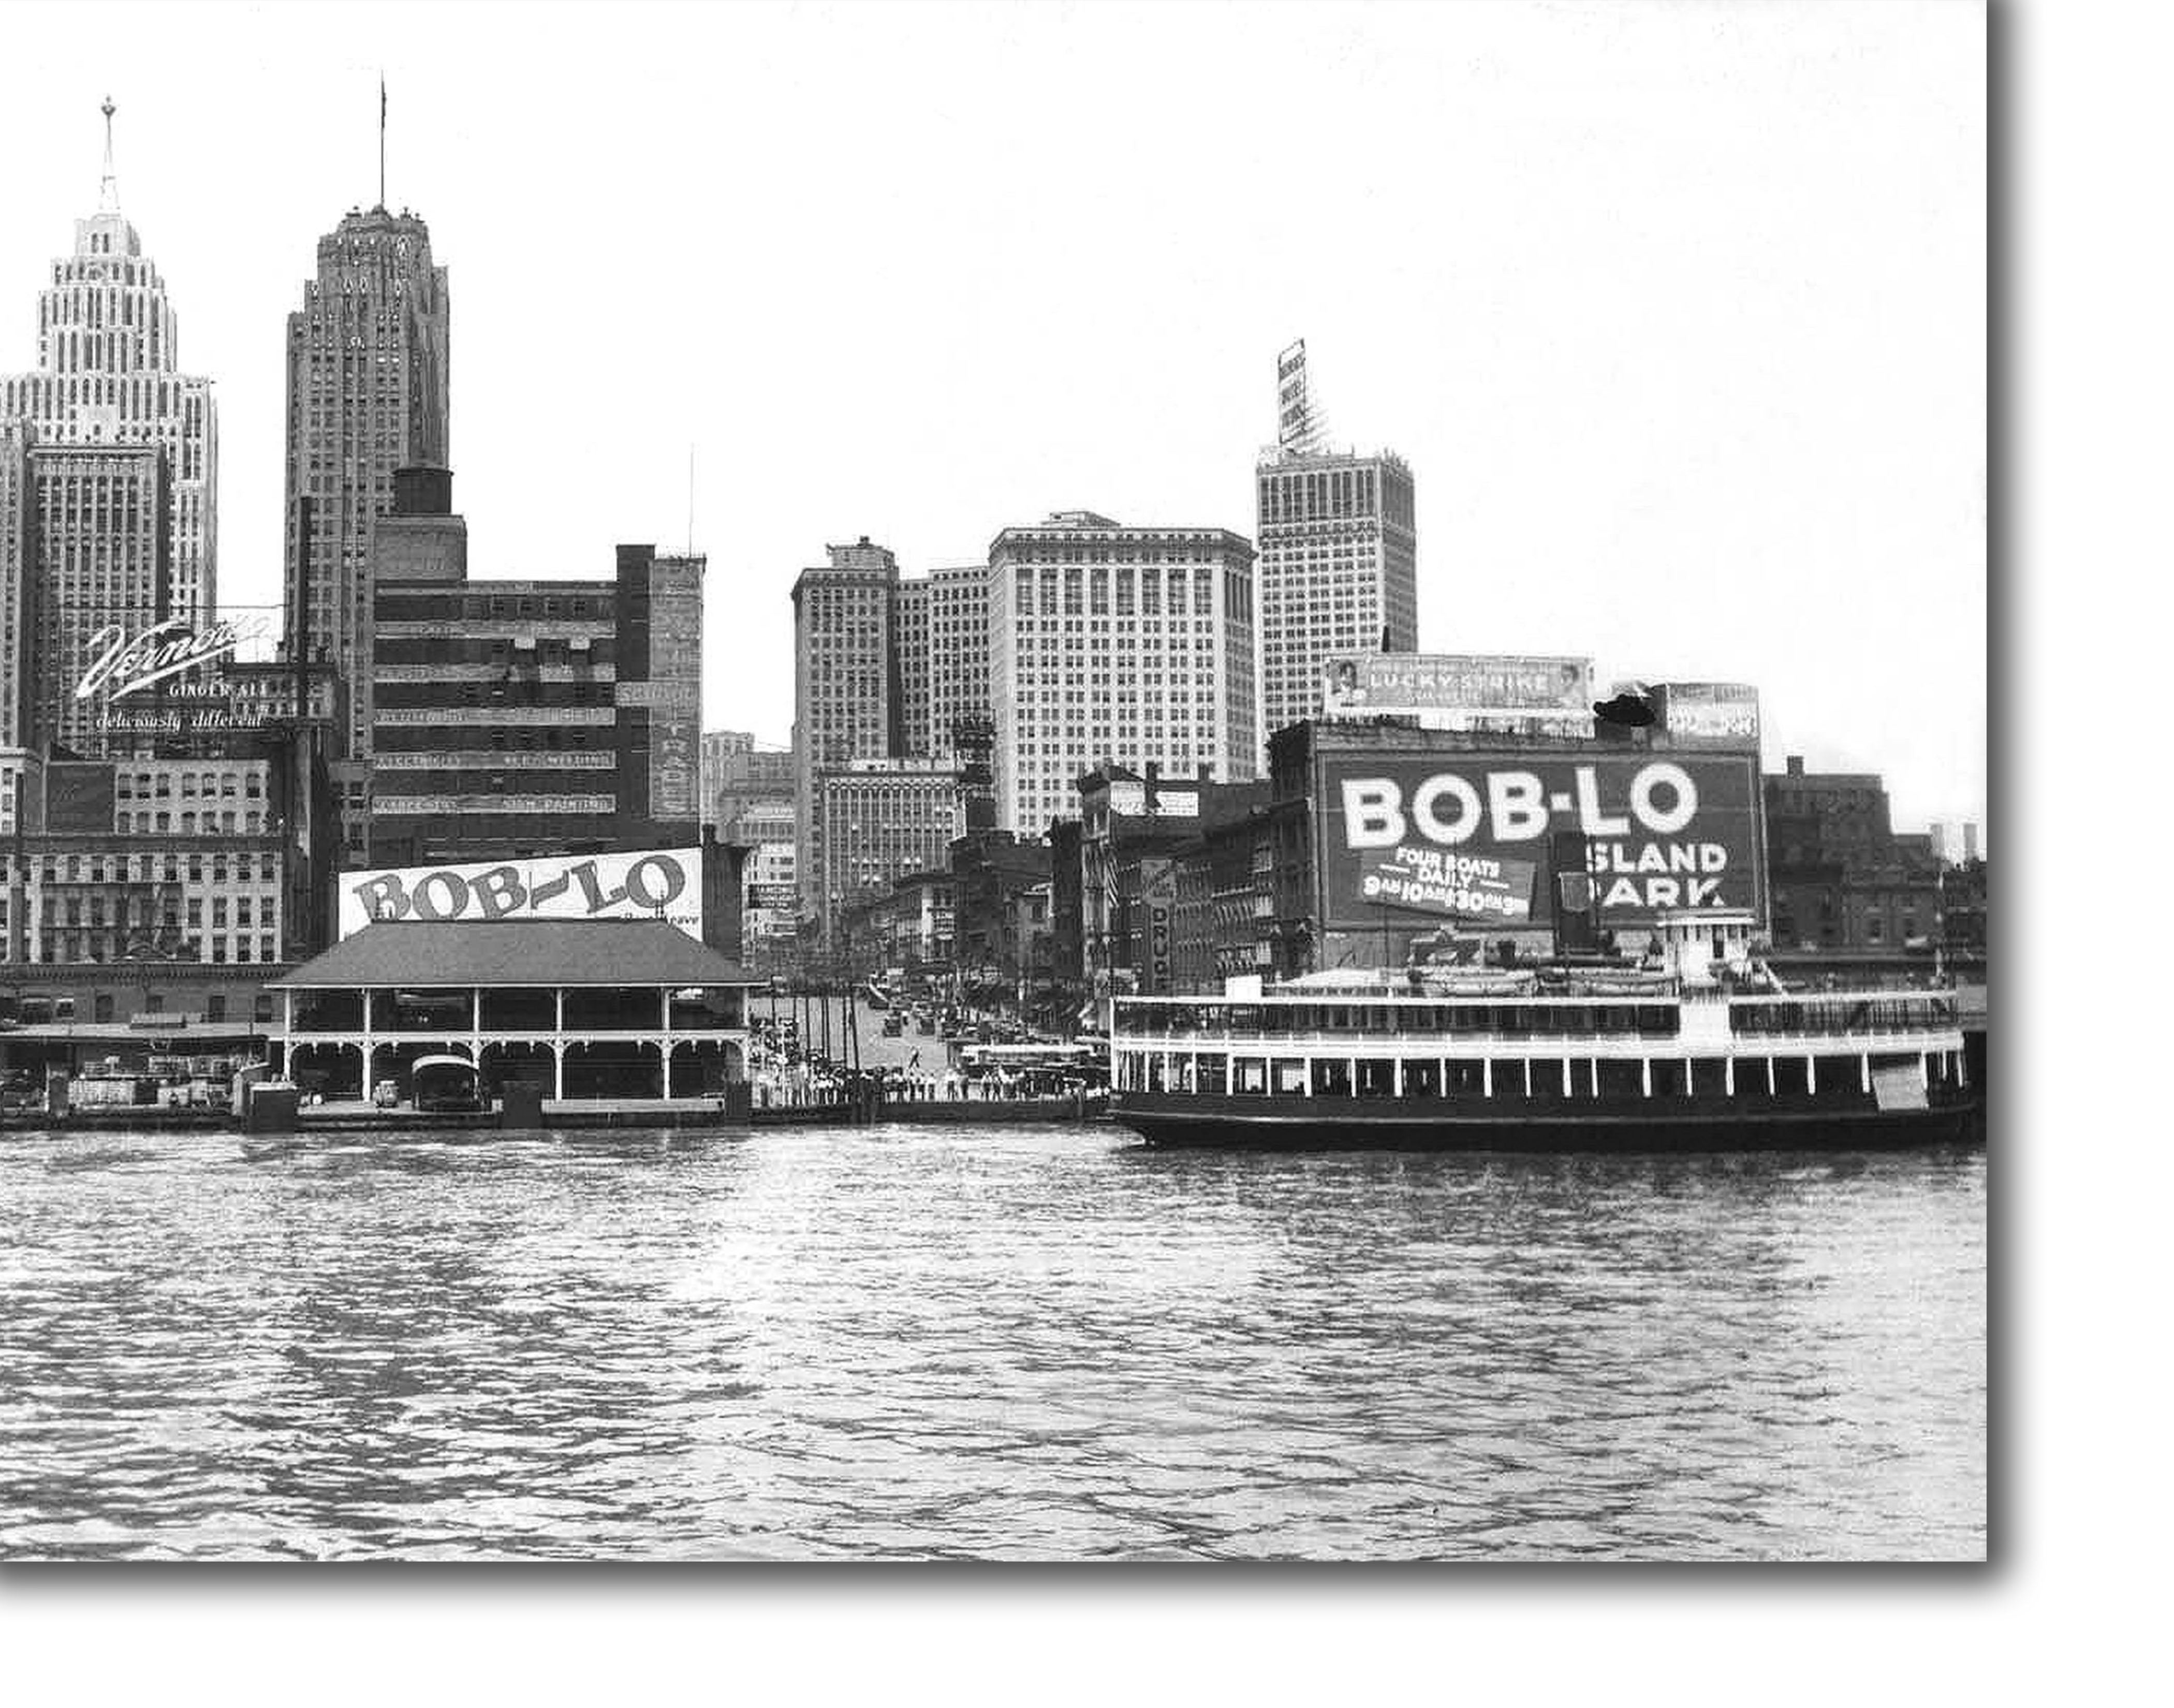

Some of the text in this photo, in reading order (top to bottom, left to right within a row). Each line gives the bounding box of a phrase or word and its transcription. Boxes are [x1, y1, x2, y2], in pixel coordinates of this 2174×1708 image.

[169, 683, 230, 698] GINGER
[1342, 762, 1698, 849] BOB-LO
[1397, 846, 1500, 878] FOUR BOATS
[353, 854, 686, 919] BOB-LO
